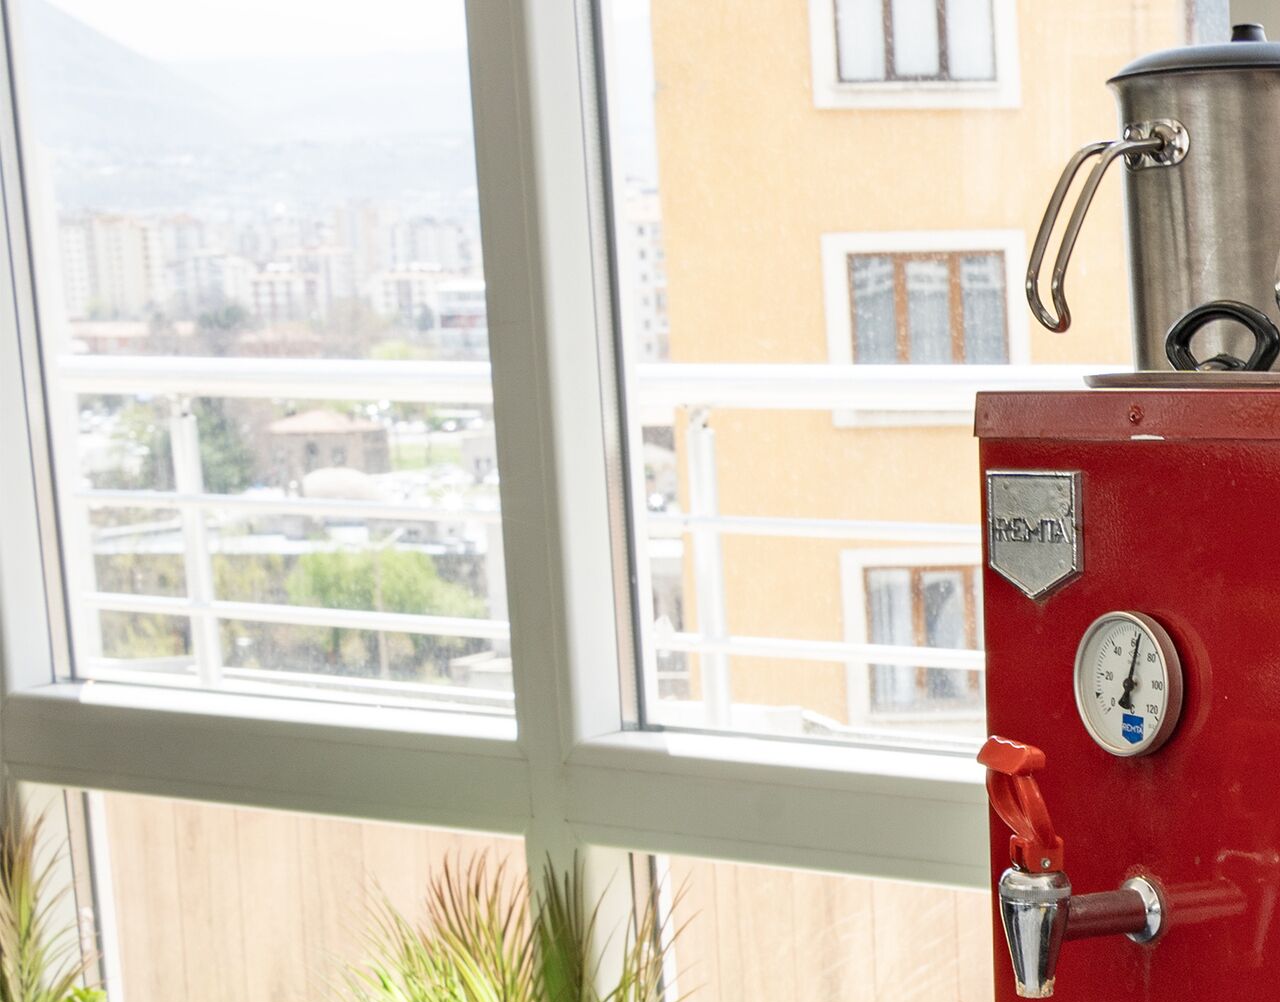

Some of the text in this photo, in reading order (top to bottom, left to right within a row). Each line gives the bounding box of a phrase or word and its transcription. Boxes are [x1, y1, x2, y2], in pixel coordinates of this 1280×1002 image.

[1113, 646, 1122, 656] 40
[1147, 653, 1156, 663] 80
[1105, 671, 1114, 681] 20
[1151, 680, 1163, 691] 100
[1110, 697, 1116, 707] 0
[1146, 704, 1158, 714] 120
